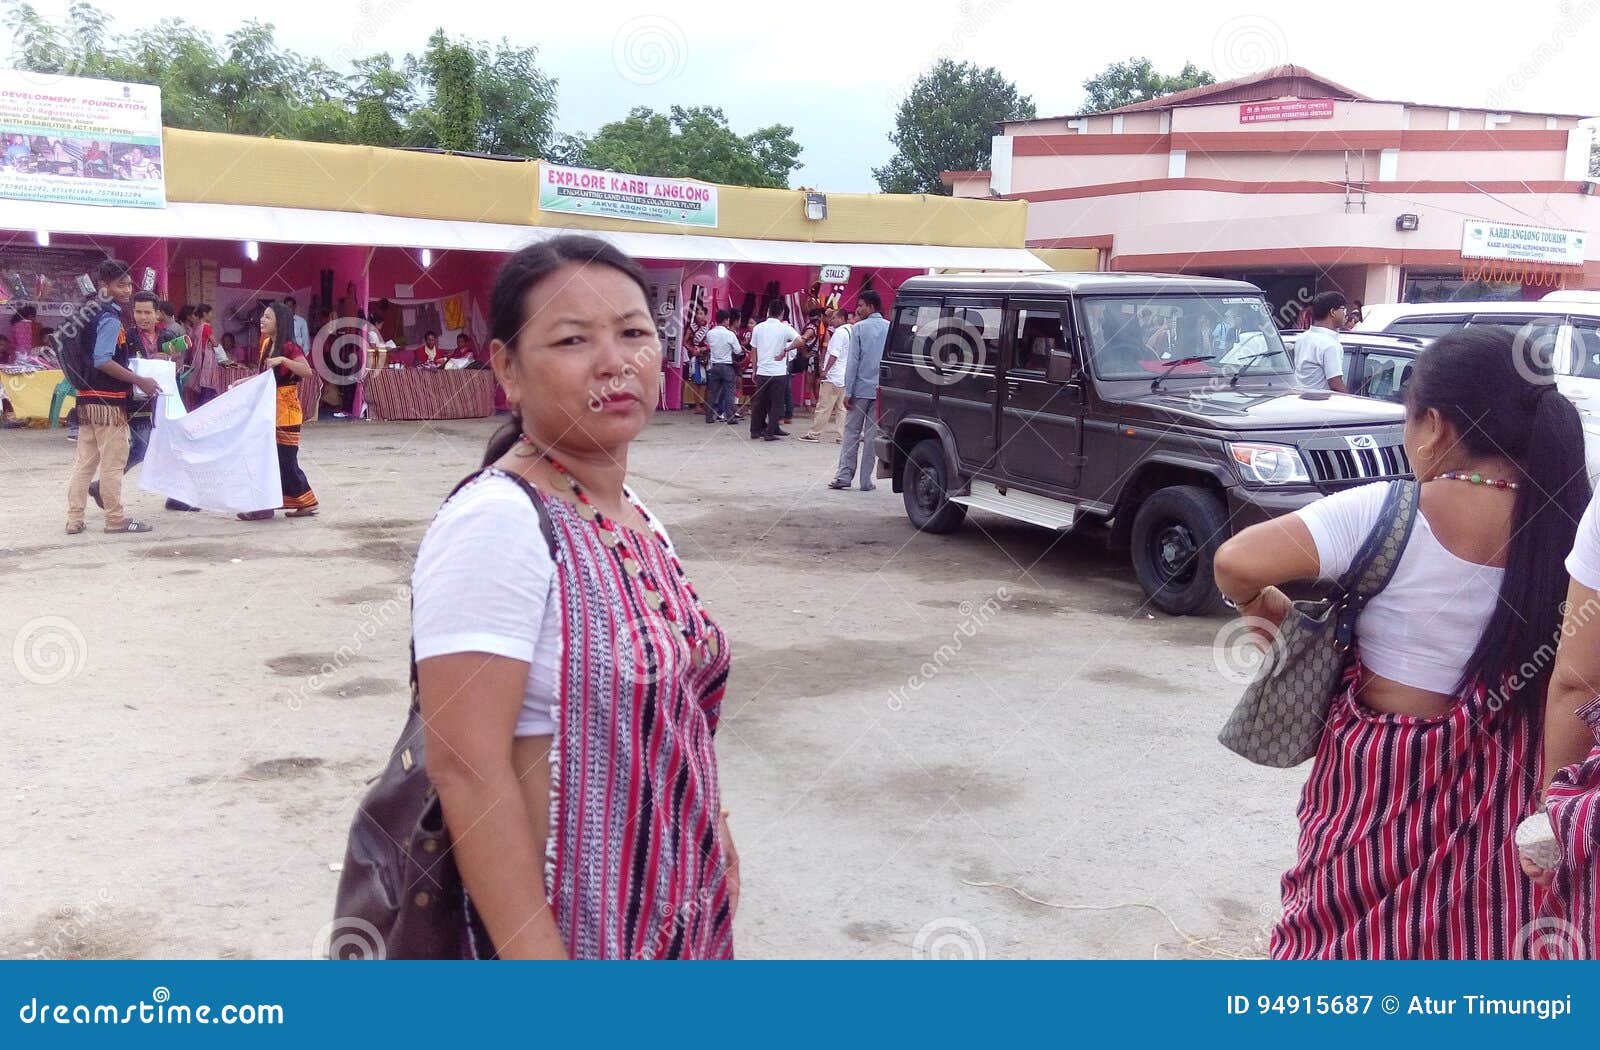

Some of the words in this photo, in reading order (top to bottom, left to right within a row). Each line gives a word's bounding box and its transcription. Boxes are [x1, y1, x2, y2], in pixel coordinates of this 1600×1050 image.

[1, 90, 77, 104] DEVELOPMENT
[82, 99, 148, 112] FOUNDATION
[548, 169, 606, 190] EXPLORE
[611, 177, 648, 195] KARBI
[654, 183, 710, 202] ANGLONG
[1489, 227, 1510, 238] KARBI
[1511, 229, 1540, 241] ANGLONG
[1541, 232, 1567, 244] TOURISM
[825, 269, 845, 278] STALLS
